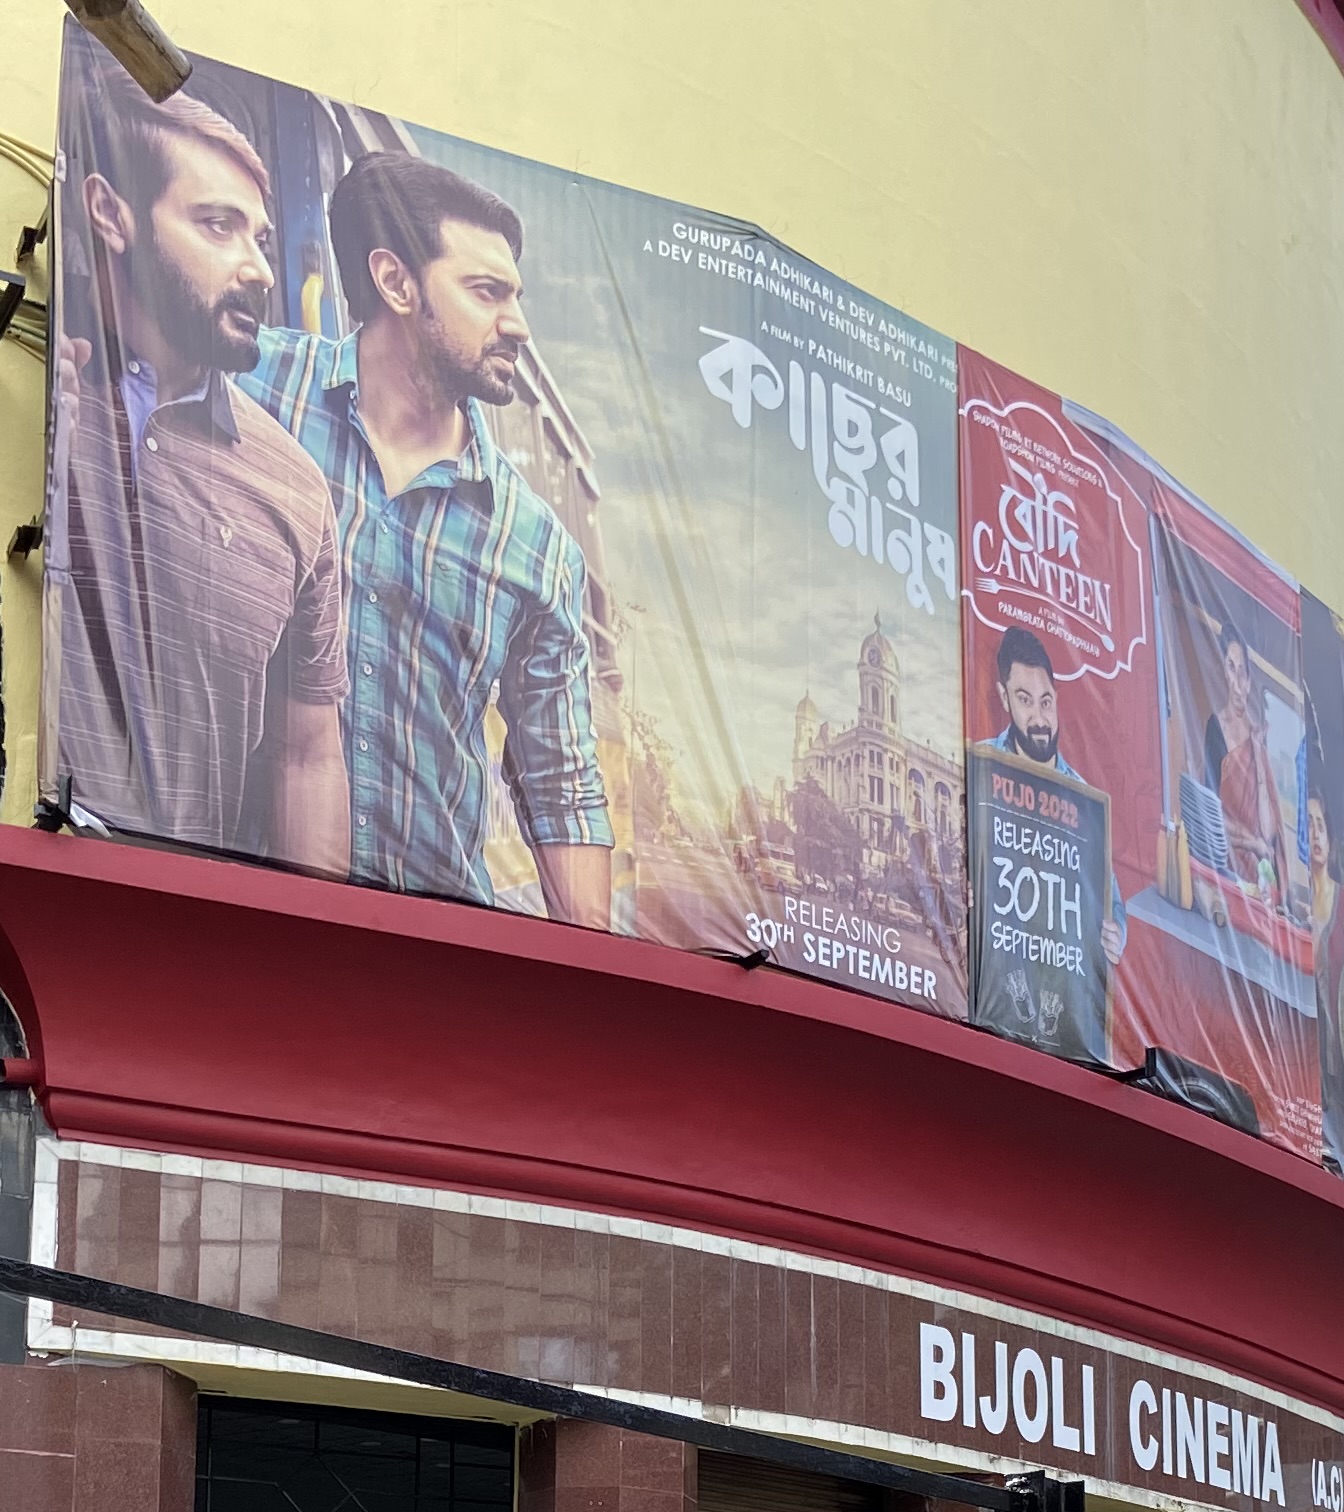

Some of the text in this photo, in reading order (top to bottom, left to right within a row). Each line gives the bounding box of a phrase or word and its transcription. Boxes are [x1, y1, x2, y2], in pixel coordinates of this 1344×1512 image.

[643, 239, 653, 253] A
[658, 240, 692, 264] DEV
[698, 252, 816, 316] ENTERTAINMENT
[818, 304, 881, 353] VENTURES
[883, 341, 910, 368] PVT.
[912, 356, 937, 383] LTD.
[672, 222, 767, 267] GURUPADA
[770, 257, 834, 305] ADHIKARI
[836, 295, 846, 312] &
[849, 301, 875, 327] DEV
[878, 319, 939, 363] ADHIKARI
[760, 320, 912, 408] A FILM BY PATHIKRIT BASU
[698, 326, 920, 507] কাছের
[828, 476, 956, 616] মানুষ
[972, 520, 1113, 633] CANTEEN
[992, 773, 1080, 829] PUJO 2022
[993, 816, 1081, 873] RELEASING
[784, 896, 902, 954] RELEASING
[992, 856, 1083, 940] 30TH
[745, 912, 938, 1000] 30TH SEPTEMBER
[991, 921, 1086, 977] SEPTEMBER
[919, 1321, 1096, 1456] BIJOLI
[1128, 1379, 1286, 1508] CINEMA
